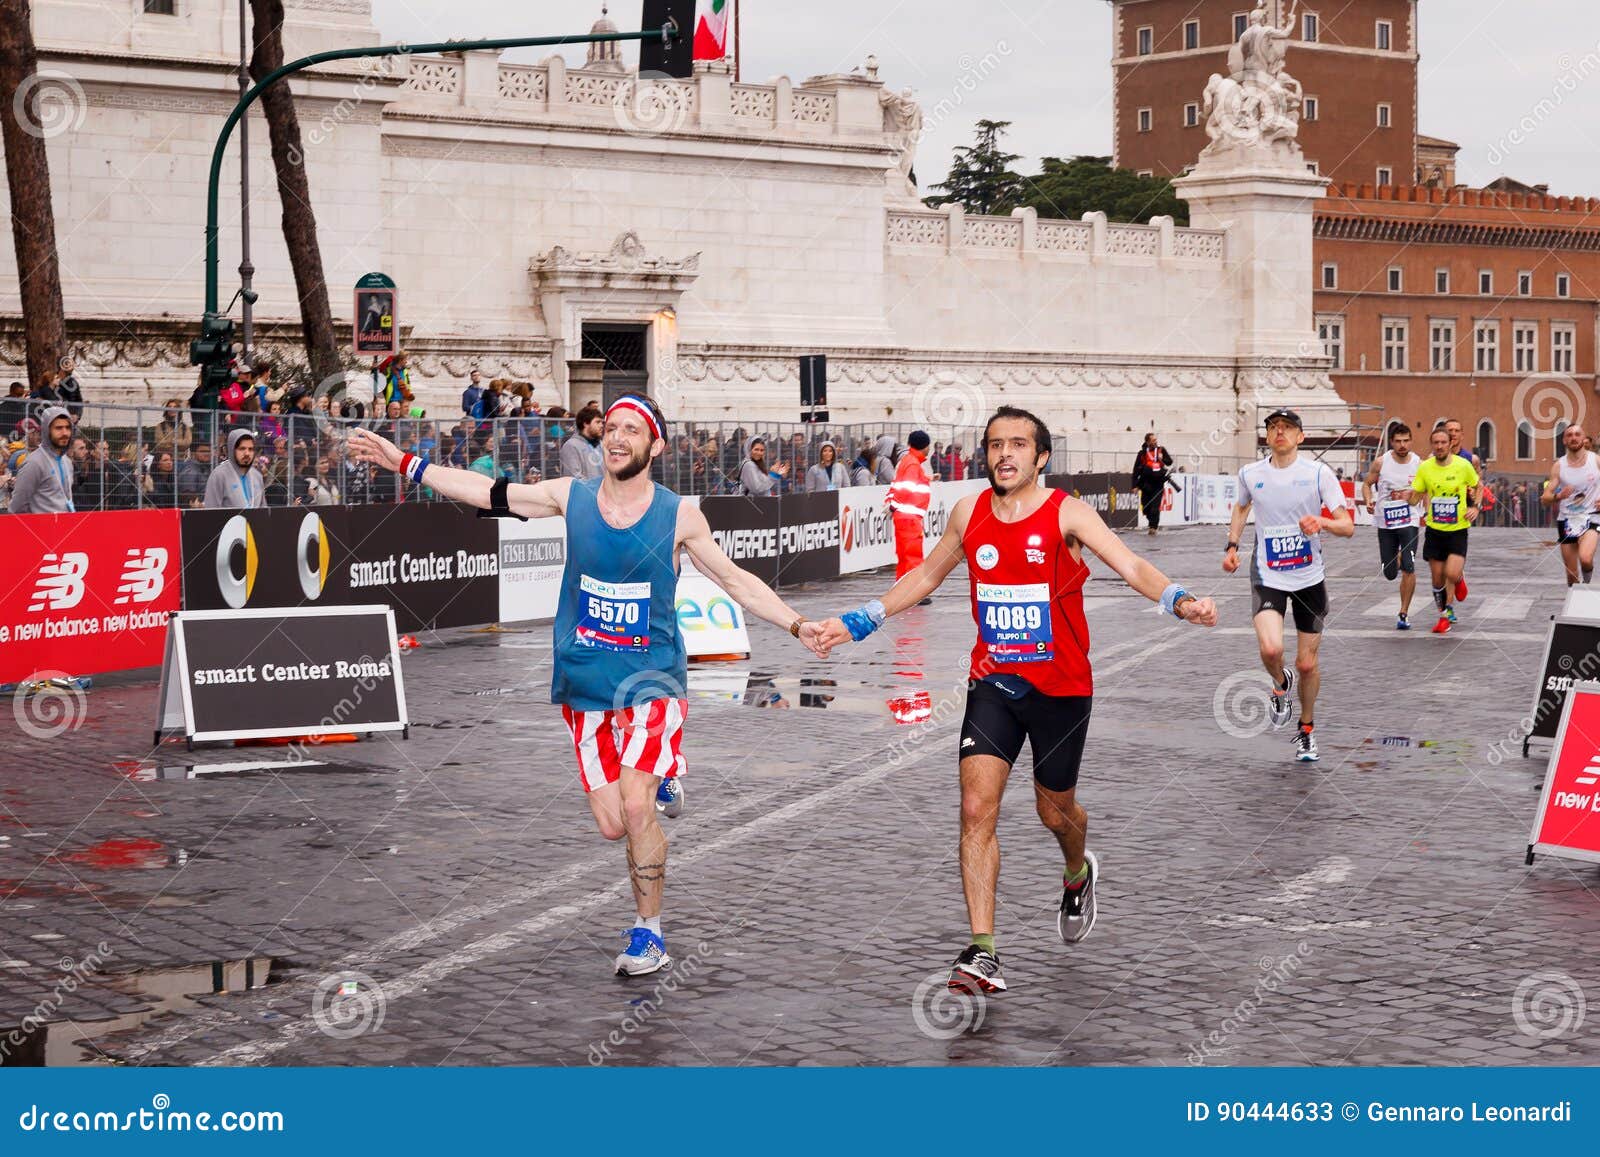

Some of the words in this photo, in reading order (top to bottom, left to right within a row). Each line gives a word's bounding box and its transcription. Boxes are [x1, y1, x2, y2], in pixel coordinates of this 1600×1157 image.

[711, 528, 778, 560] OWERADE
[779, 519, 840, 555] POWERADE
[1272, 536, 1304, 553] 9132
[503, 543, 526, 564] FISH
[527, 542, 562, 562] FACTOR
[350, 554, 397, 588] smart
[400, 551, 453, 584] Center
[456, 549, 499, 579] Roma
[588, 596, 639, 625] 5570
[985, 605, 1042, 630] 4089
[14, 620, 43, 642] new
[103, 611, 130, 633] new
[129, 609, 169, 630] balanc
[599, 622, 616, 633] RAUL
[996, 632, 1021, 641] FILIPPO
[194, 664, 257, 685] smart
[261, 662, 331, 682] Center
[335, 660, 392, 679] Roma
[1554, 791, 1591, 810] new
